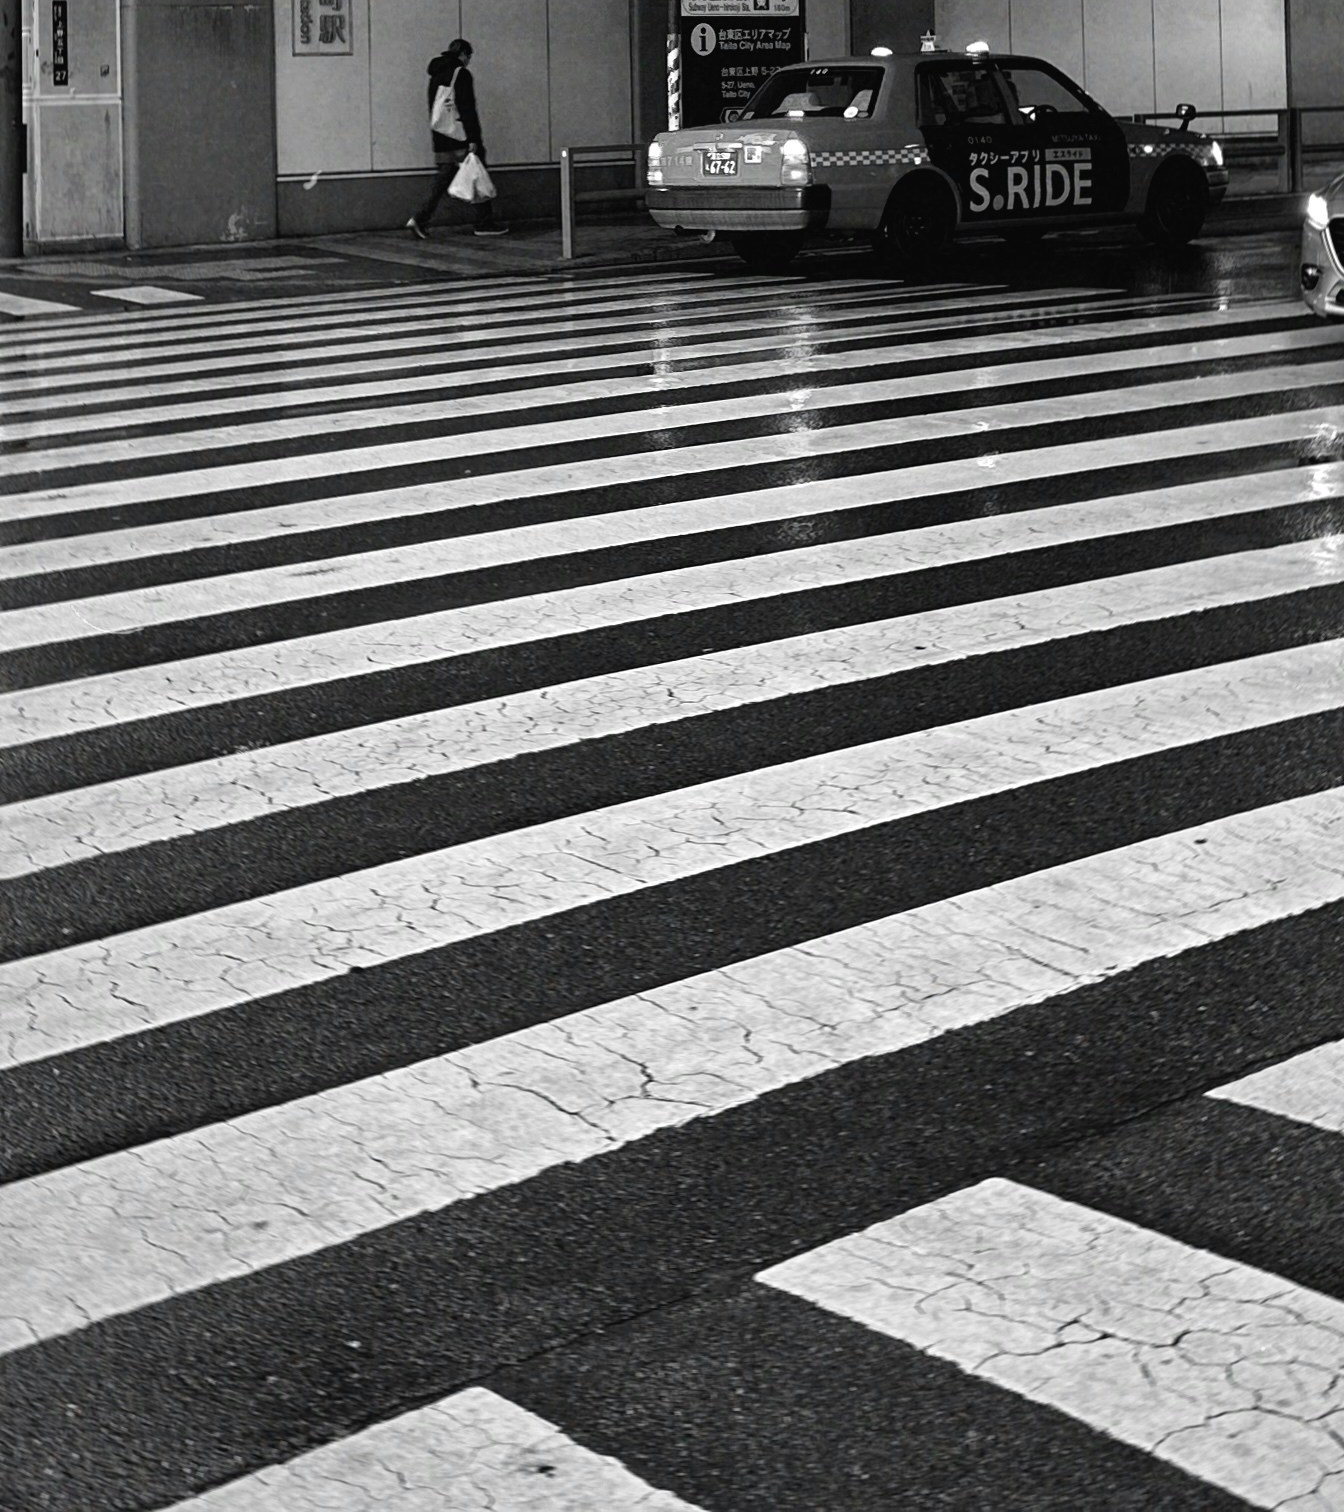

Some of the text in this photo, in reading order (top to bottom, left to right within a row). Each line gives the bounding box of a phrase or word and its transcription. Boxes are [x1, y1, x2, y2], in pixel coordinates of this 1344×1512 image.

[719, 28, 791, 40] 台東区エリアマップ
[740, 41, 755, 51] City
[756, 41, 774, 49] Area
[776, 41, 791, 50] Map
[56, 71, 66, 81] 27
[721, 67, 758, 76] 台東区上野
[738, 90, 751, 99] City
[967, 136, 992, 144] 0140
[969, 150, 1040, 166] タクシーアプリ
[969, 162, 1093, 213] S.RIDE
